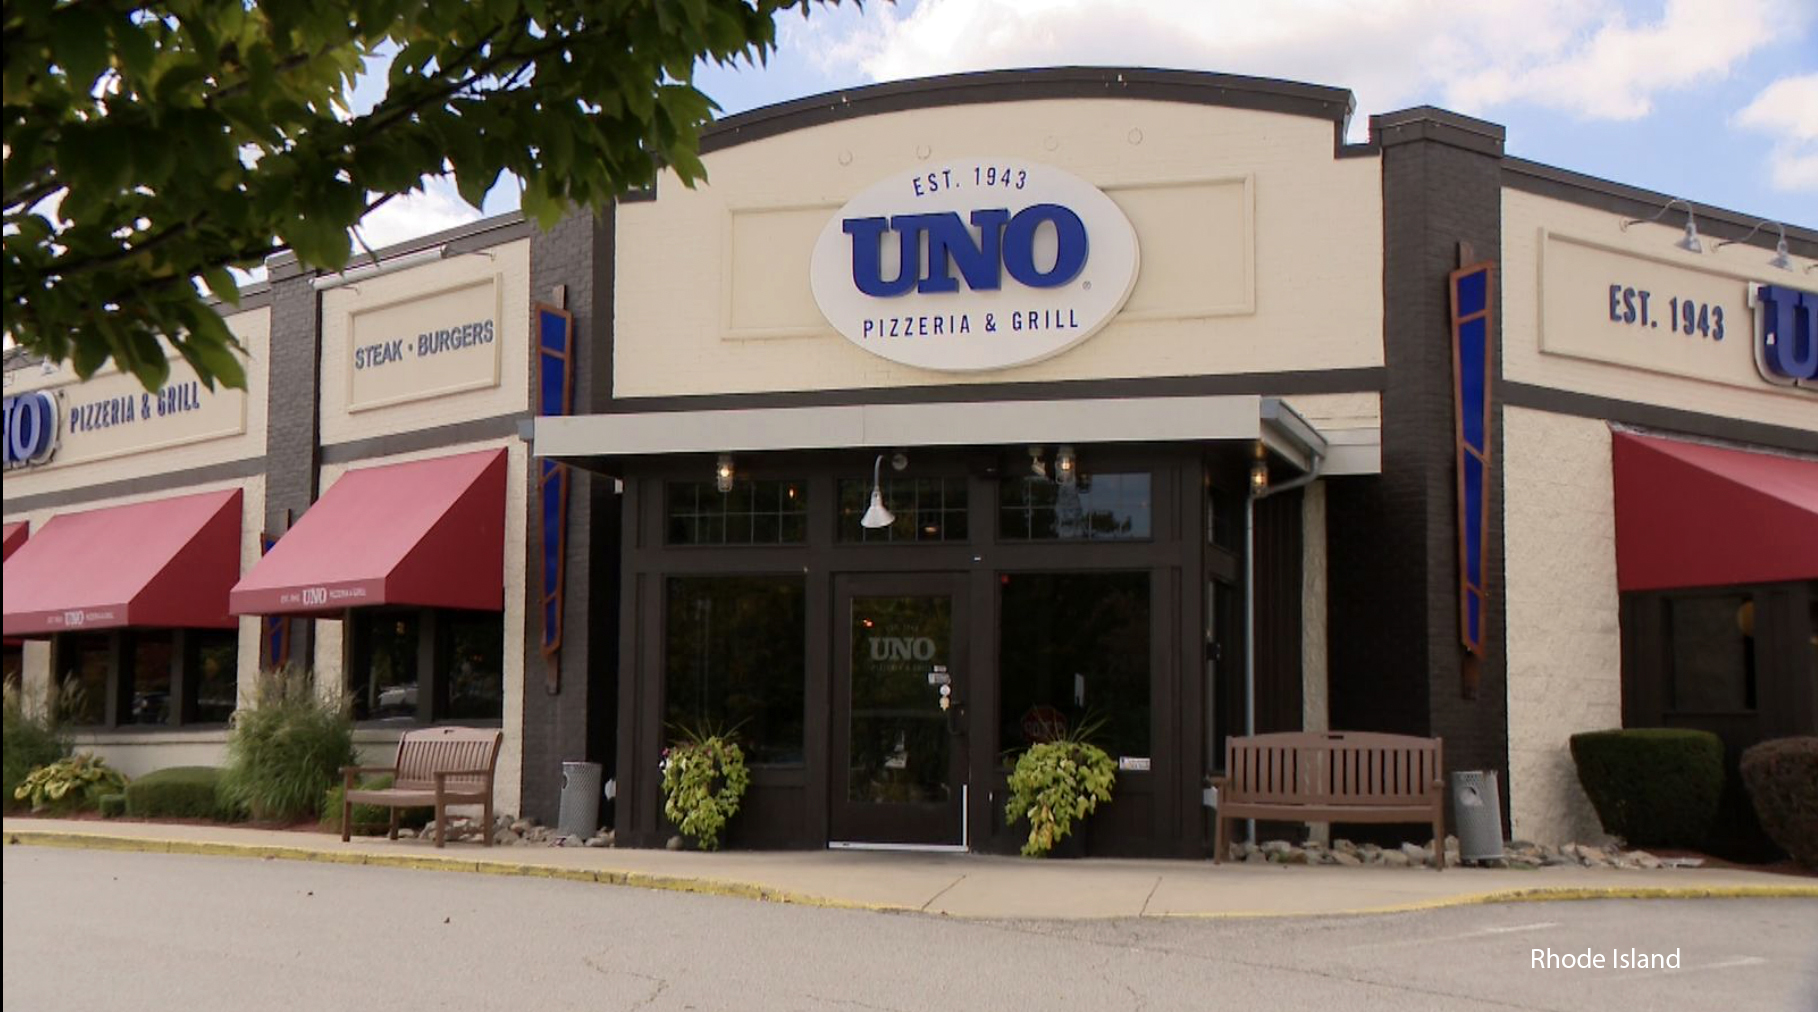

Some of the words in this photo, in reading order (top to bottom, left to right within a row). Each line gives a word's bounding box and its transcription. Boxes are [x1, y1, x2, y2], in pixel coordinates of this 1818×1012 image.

[912, 168, 960, 197] EST.
[974, 167, 1027, 190] 1943
[842, 203, 1090, 297] UNO
[863, 314, 971, 338] PIZZERIA
[985, 312, 997, 332] &
[1012, 309, 1079, 331] GRILL
[1609, 284, 1657, 328] EST.
[1670, 296, 1724, 341] 1943
[355, 339, 403, 370] STEAK
[418, 319, 493, 357] BURGERS
[70, 395, 135, 433] PIZZERIA
[141, 392, 151, 420] &
[157, 381, 200, 416] GRILL
[303, 587, 327, 605] UNO
[868, 637, 936, 661] UNO
